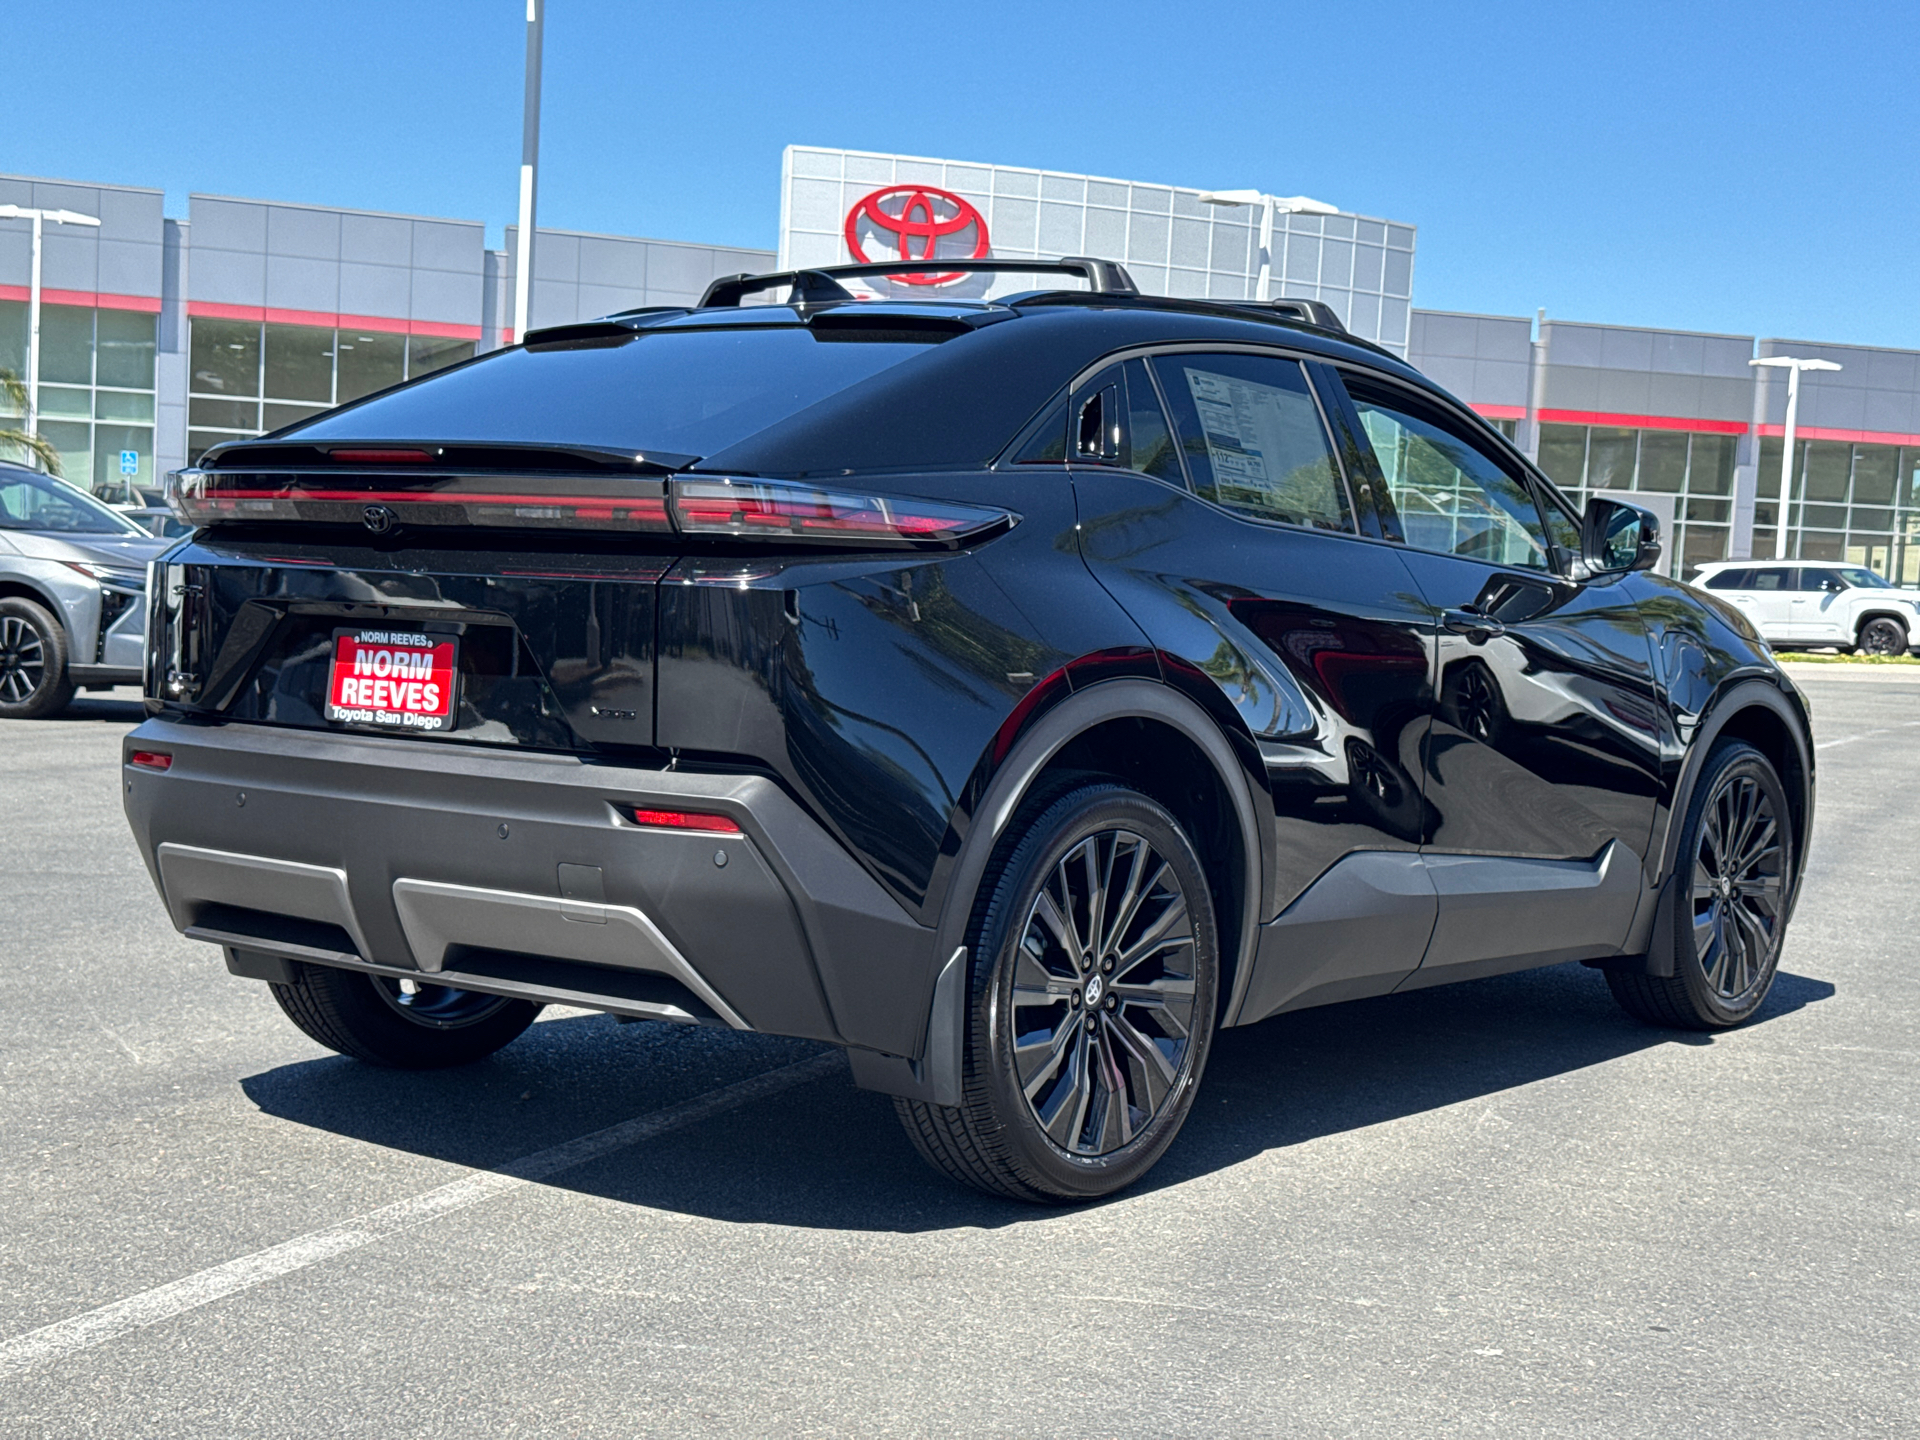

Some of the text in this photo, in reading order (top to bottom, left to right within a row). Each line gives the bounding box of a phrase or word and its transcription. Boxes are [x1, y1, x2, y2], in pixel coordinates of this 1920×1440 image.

[361, 631, 427, 646] NORM REEVES
[340, 649, 440, 711] NORM REEVES
[331, 705, 442, 730] Toyota San Diego
